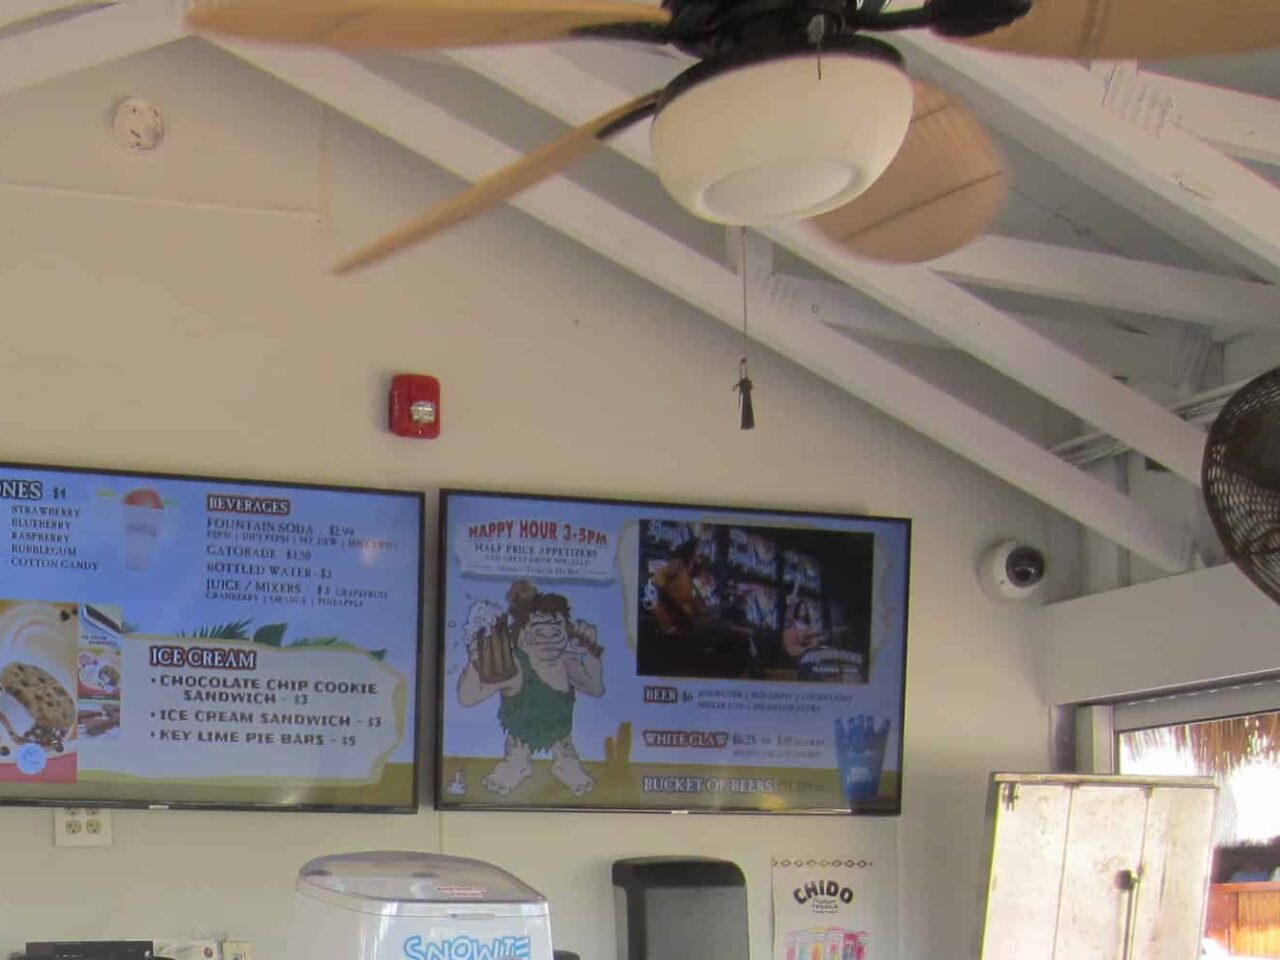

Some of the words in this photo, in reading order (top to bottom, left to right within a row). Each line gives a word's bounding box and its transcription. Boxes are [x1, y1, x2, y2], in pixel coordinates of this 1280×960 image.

[11, 504, 81, 518] STRAWBERRY
[208, 496, 290, 514] BEVERAGES
[11, 518, 71, 530] BLUEBERRY
[206, 518, 275, 532] FOUNTAIN
[278, 521, 314, 535] SODA
[11, 531, 70, 543] RASPBERRY
[469, 520, 514, 540] HAPPY
[520, 520, 558, 540] HOUR
[563, 522, 608, 546] 3-5PM
[11, 544, 77, 556] BUBBLEGUM
[206, 546, 277, 558] GATORADE
[475, 544, 504, 553] HALF
[506, 544, 535, 555] PRICE
[538, 546, 598, 559] APPETIZERS
[11, 558, 58, 570] COTTON
[60, 560, 99, 571] CANDY
[206, 562, 264, 576] BOTTLED
[269, 566, 312, 578] WATER
[206, 578, 240, 592] JUICE
[255, 581, 302, 594] MIXERS
[150, 646, 183, 667] ICE
[187, 648, 257, 669] CREAM
[160, 674, 260, 690] CHOCOLATE
[267, 679, 308, 692] CHIP
[314, 681, 378, 694] COOKIE
[183, 690, 277, 705] SANDWICH
[644, 687, 677, 703] BEER
[160, 709, 188, 722] ICE
[195, 710, 253, 724] CREAM
[260, 712, 351, 727] SANDWICH
[160, 729, 192, 742] KEY
[198, 730, 240, 744] LIME
[246, 732, 274, 744] PIE
[280, 733, 325, 746] BARS
[644, 731, 686, 746] WHITE
[688, 732, 728, 748] CLAW
[644, 776, 704, 792] BUCKET
[707, 778, 727, 792] OF
[730, 778, 771, 793] BEERS
[793, 880, 854, 905] CHIDO
